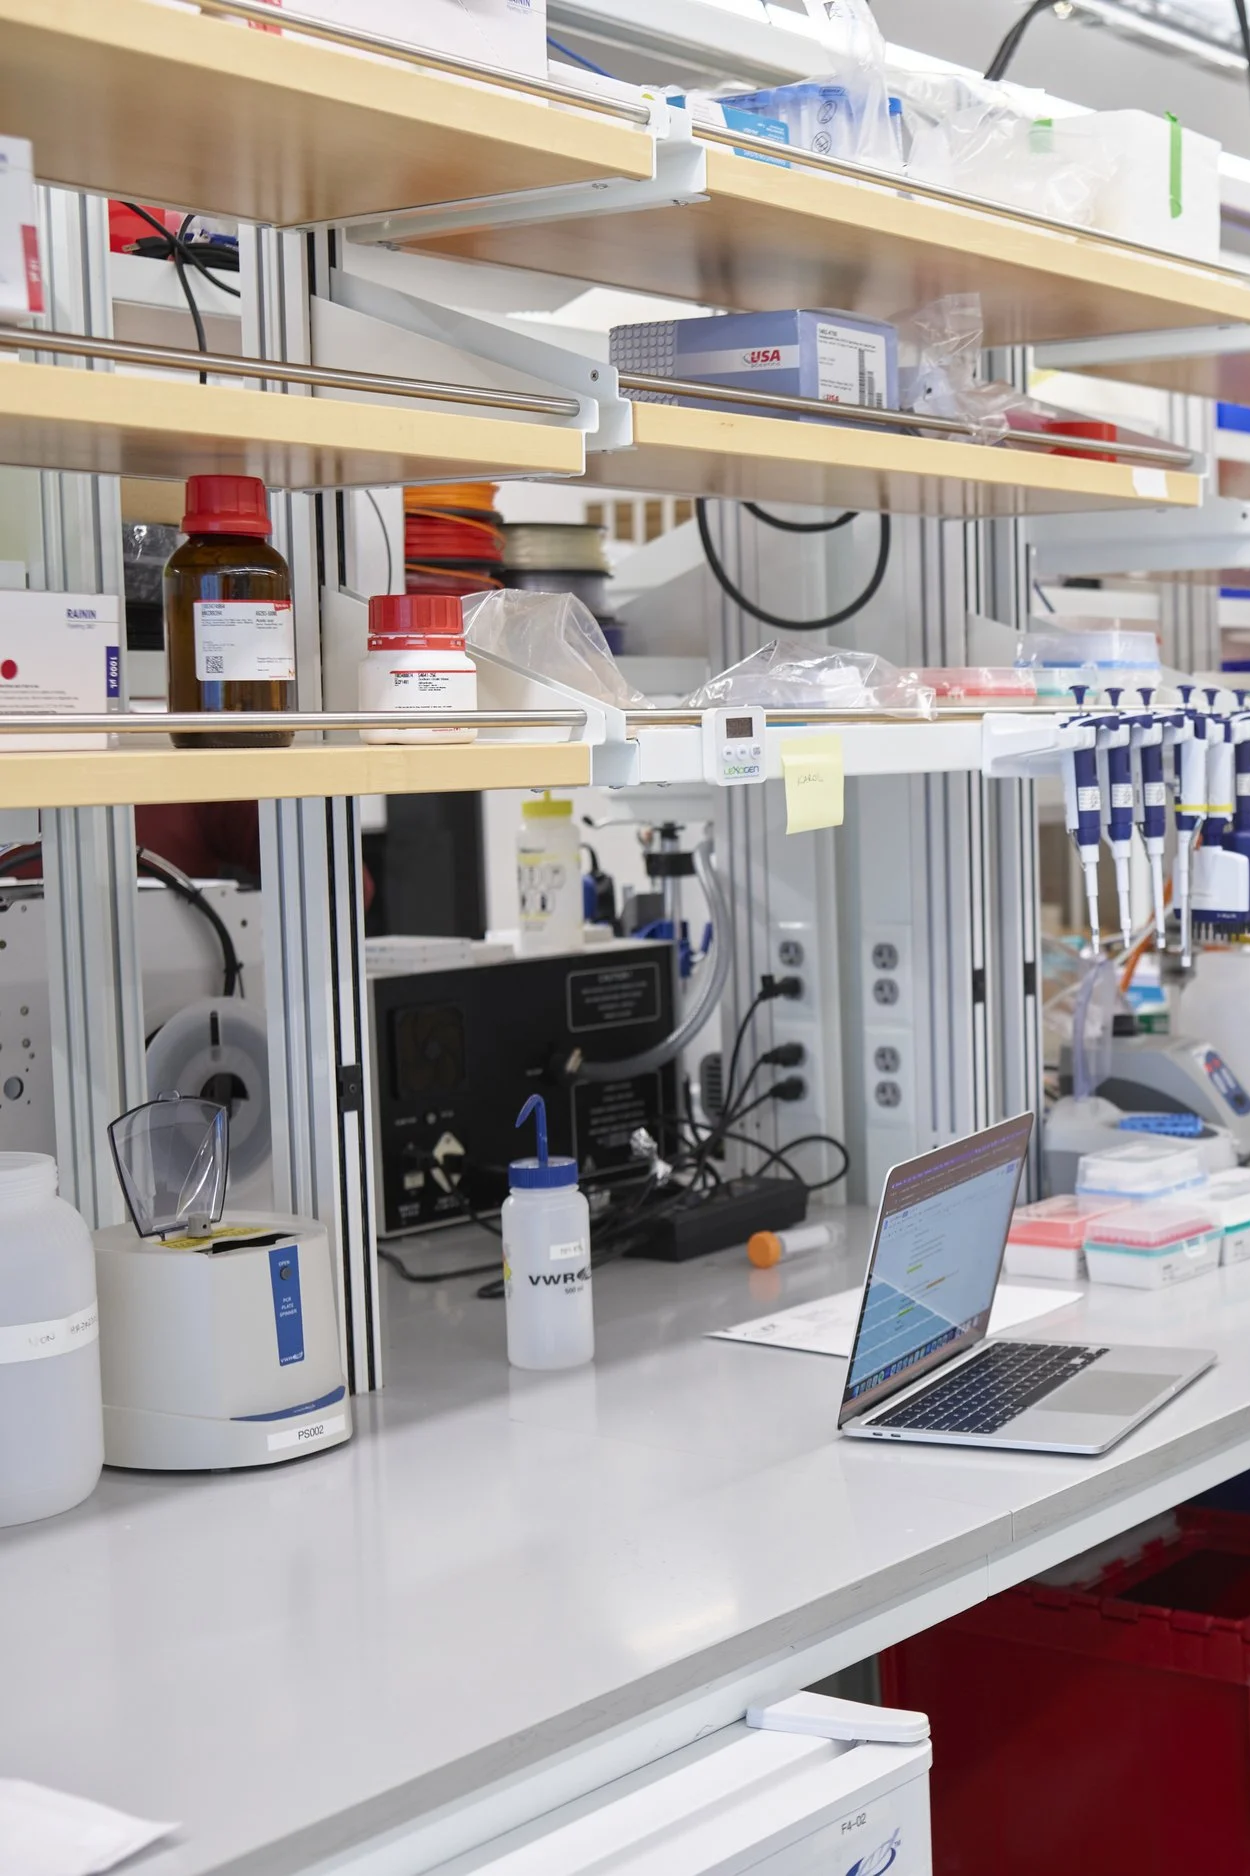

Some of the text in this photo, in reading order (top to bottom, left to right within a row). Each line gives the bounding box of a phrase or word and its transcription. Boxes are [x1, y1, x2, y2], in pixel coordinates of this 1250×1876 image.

[751, 350, 781, 363] USA
[66, 608, 97, 619] RAININ
[110, 656, 118, 677] 1000
[724, 765, 760, 776] LEXOGEN
[528, 1272, 576, 1287] VWR
[279, 1309, 297, 1318] SPINNER
[297, 1425, 325, 1441] PS002
[841, 1813, 867, 1836] F4-02
